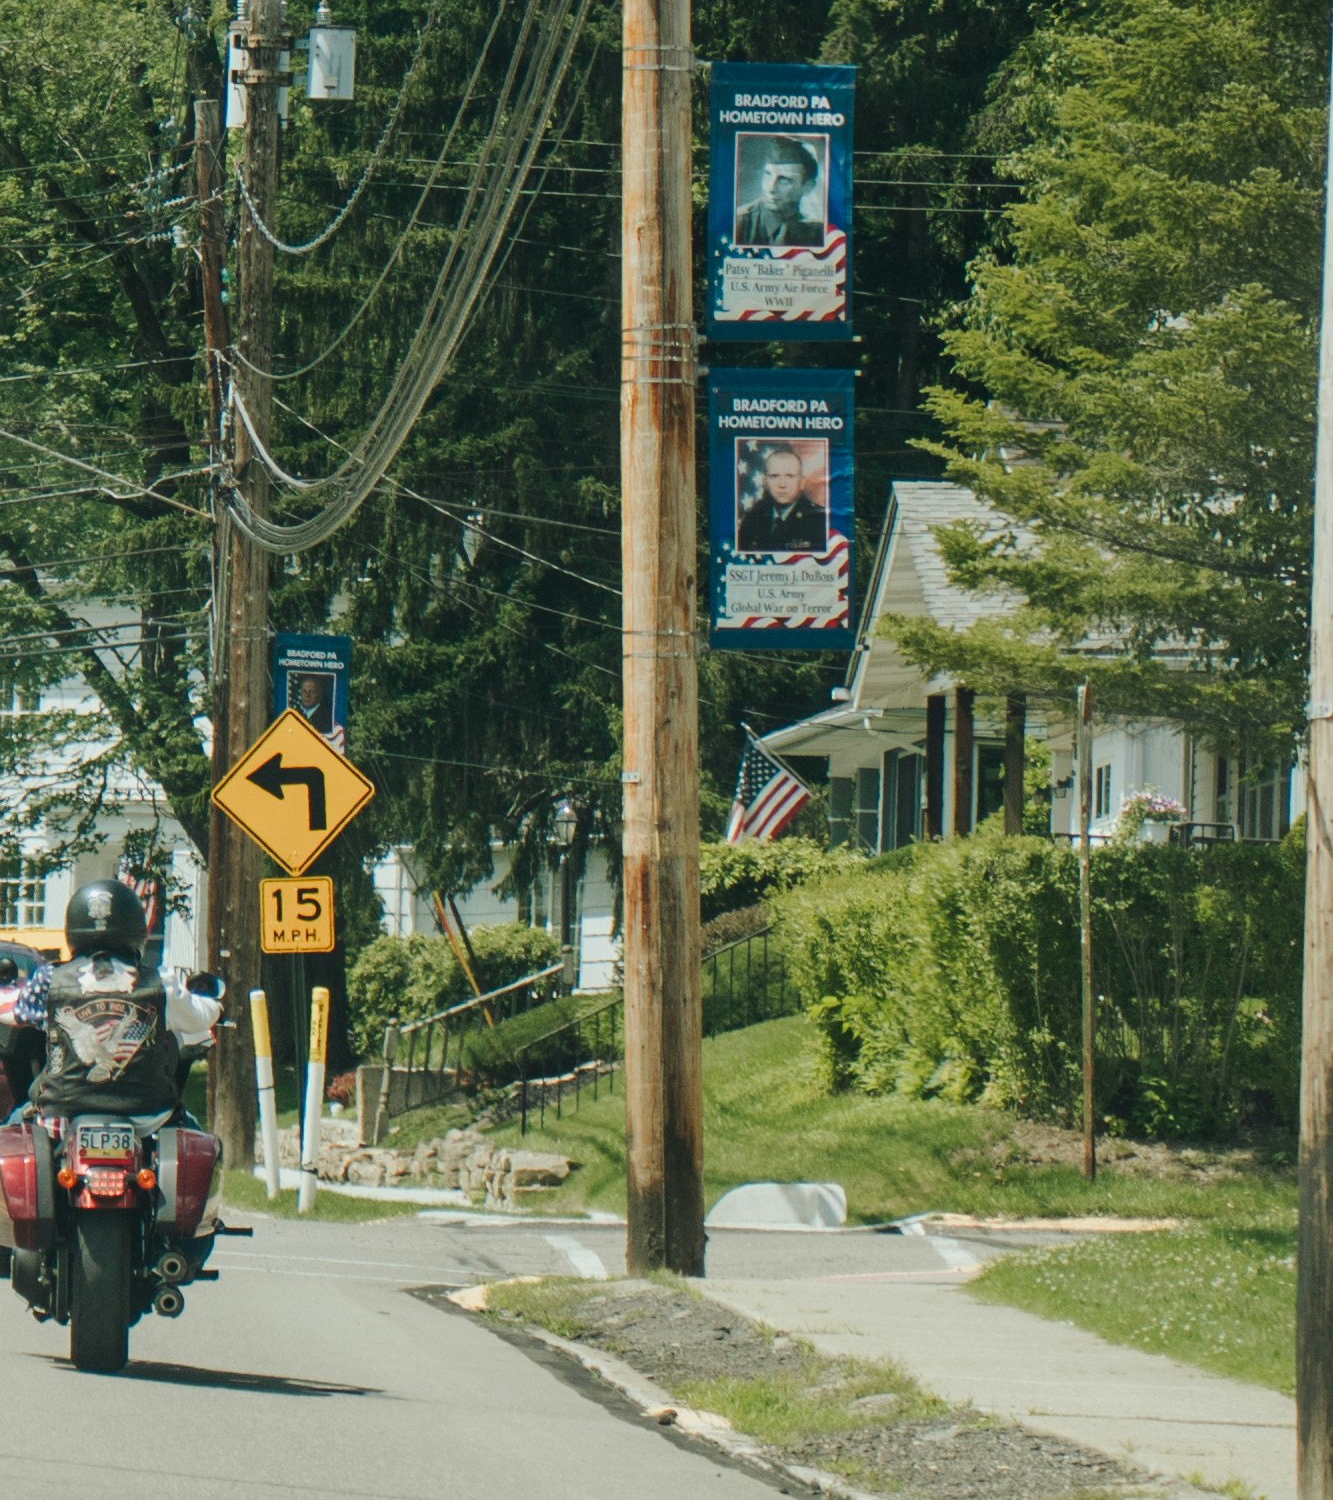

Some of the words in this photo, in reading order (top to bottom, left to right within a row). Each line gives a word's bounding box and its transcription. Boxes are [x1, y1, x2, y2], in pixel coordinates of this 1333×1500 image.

[735, 94, 808, 108] BRADFORD
[811, 96, 831, 109] PA
[719, 110, 803, 125] HOMETOWN
[806, 113, 845, 127] HERO
[726, 263, 751, 278] Patsy
[730, 281, 750, 292] U.S.
[754, 282, 779, 296] Army
[783, 283, 797, 293] Air
[801, 283, 829, 293] Force
[765, 296, 793, 307] WWII
[733, 398, 807, 413] BRADFORD
[810, 400, 829, 413] PA
[719, 415, 803, 429] HOMETOWN
[805, 416, 843, 430] HERO
[729, 569, 754, 581] SSGT
[756, 570, 790, 585] Jeremy
[802, 571, 835, 582] DuBois
[758, 587, 777, 599] U.S.
[780, 588, 806, 601] Army
[731, 602, 761, 614] Global
[764, 604, 783, 613] War
[801, 603, 832, 614] Terror
[287, 649, 326, 660] BRADFORD
[278, 658, 323, 668] HOMETOWN
[324, 661, 345, 670] HERO
[272, 888, 322, 923] 15
[273, 928, 321, 943] M.P.H.
[80, 1133, 131, 1150] 5LP38
